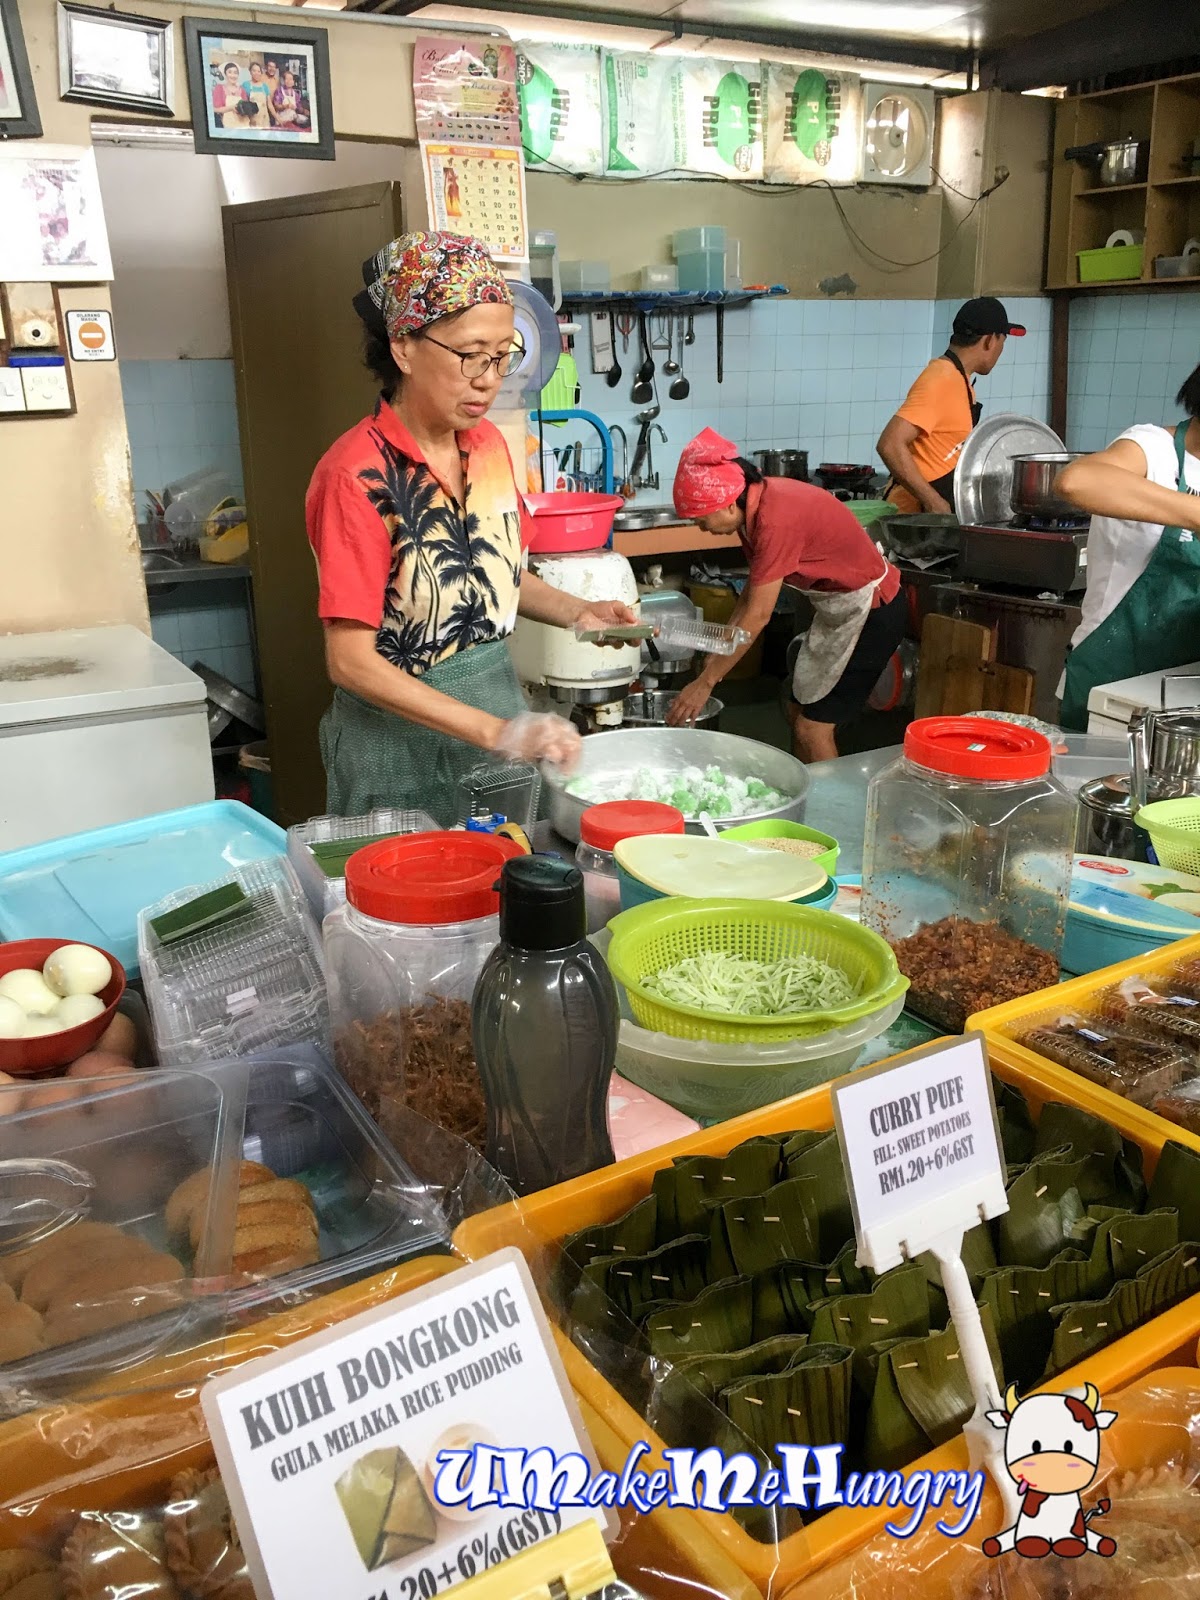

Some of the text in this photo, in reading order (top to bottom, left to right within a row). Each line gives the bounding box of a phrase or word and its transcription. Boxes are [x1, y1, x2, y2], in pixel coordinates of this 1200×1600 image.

[550, 88, 570, 142] PRAI
[702, 96, 720, 147] PRAI
[747, 82, 760, 143] GULA
[783, 92, 799, 142] PRAI
[807, 101, 820, 124] P1
[825, 80, 840, 138] GULA
[870, 1076, 964, 1138] CURRY PUFF
[873, 1110, 972, 1166] FILL: SWEET POTATOES
[878, 1134, 975, 1196] RM1.20+6%GST
[239, 1286, 521, 1450] KUIH BONGKONG
[270, 1342, 524, 1482] GULA MELAKA RICE PUDDING
